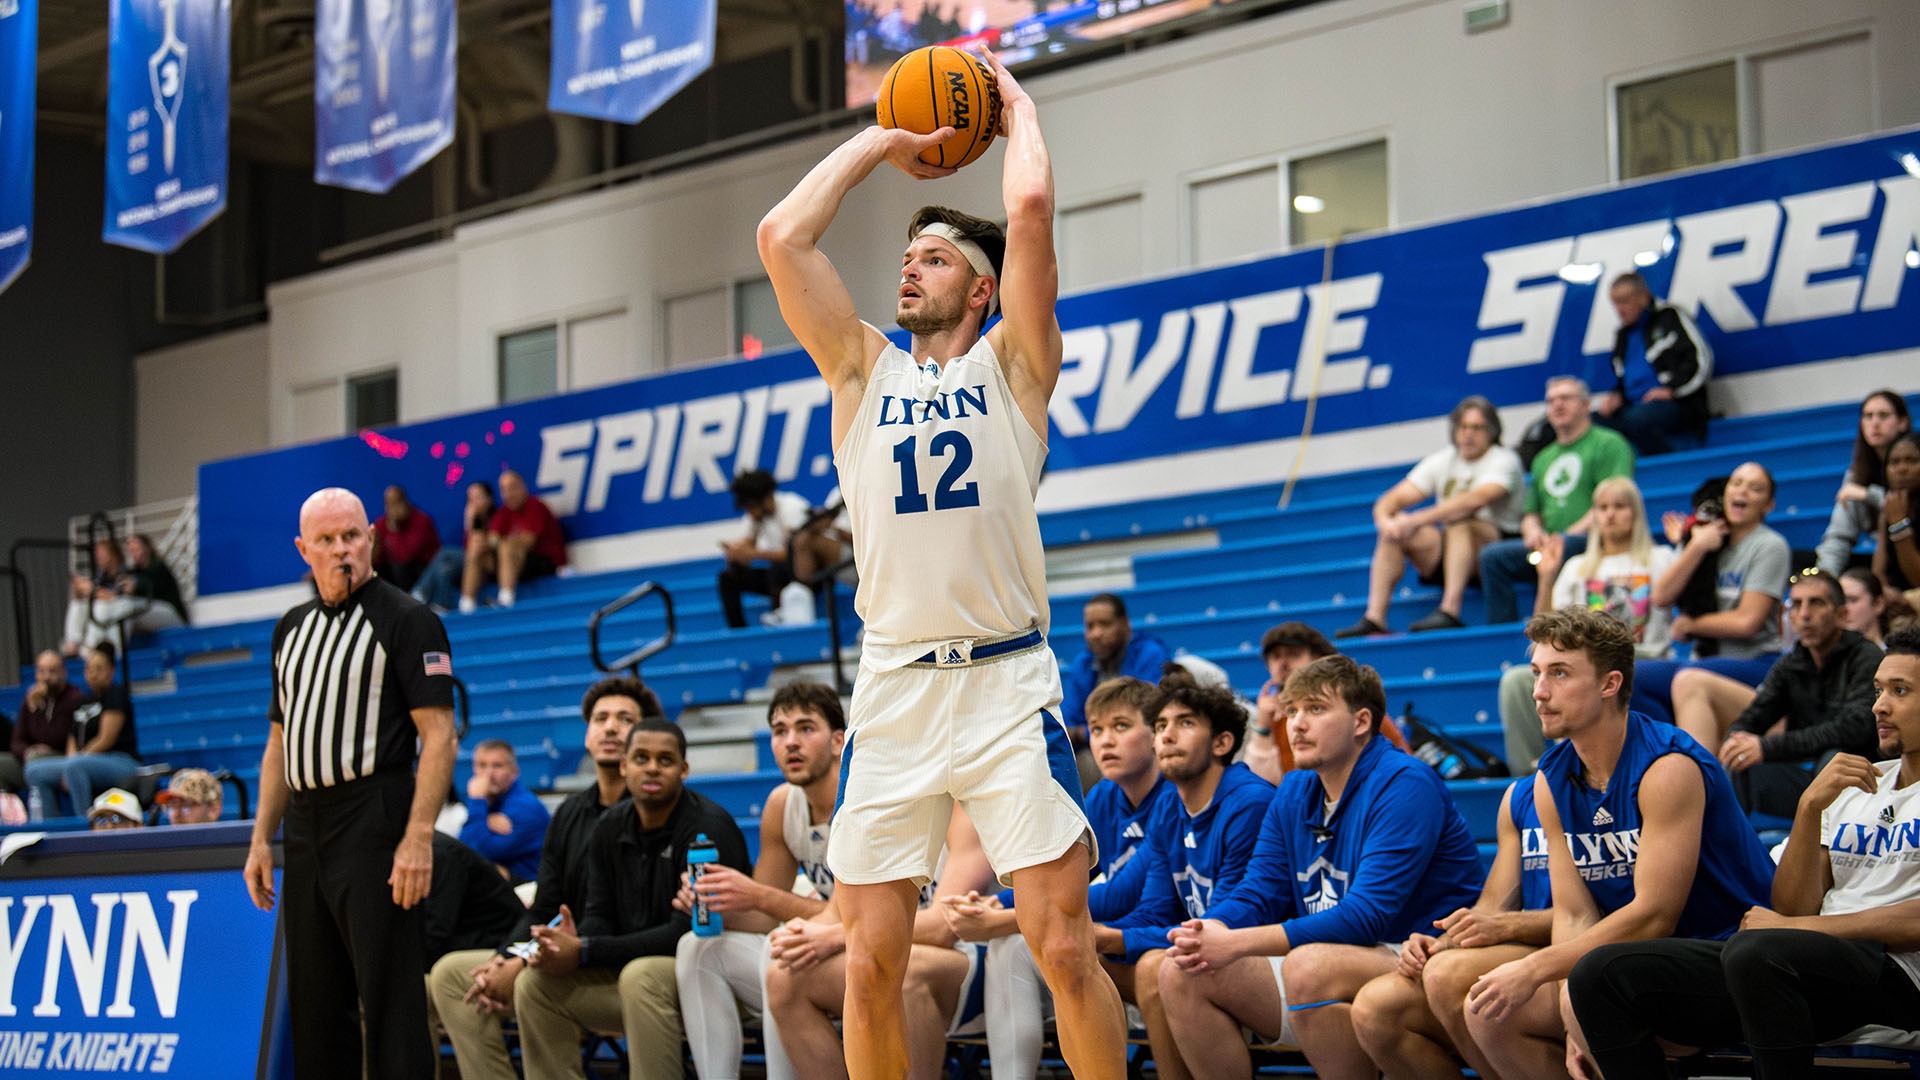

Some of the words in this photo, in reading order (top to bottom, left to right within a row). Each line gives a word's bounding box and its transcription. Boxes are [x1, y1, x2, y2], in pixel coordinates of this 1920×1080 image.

[947, 71, 970, 130] NCAA
[876, 385, 988, 427] LYNN
[536, 376, 832, 518] SPIRIT.
[893, 430, 980, 515] 12
[1829, 818, 1920, 857] LYNN
[1523, 856, 1550, 872] BAS
[0, 1031, 49, 1070] ING
[46, 1032, 180, 1073] KNIGHTS
